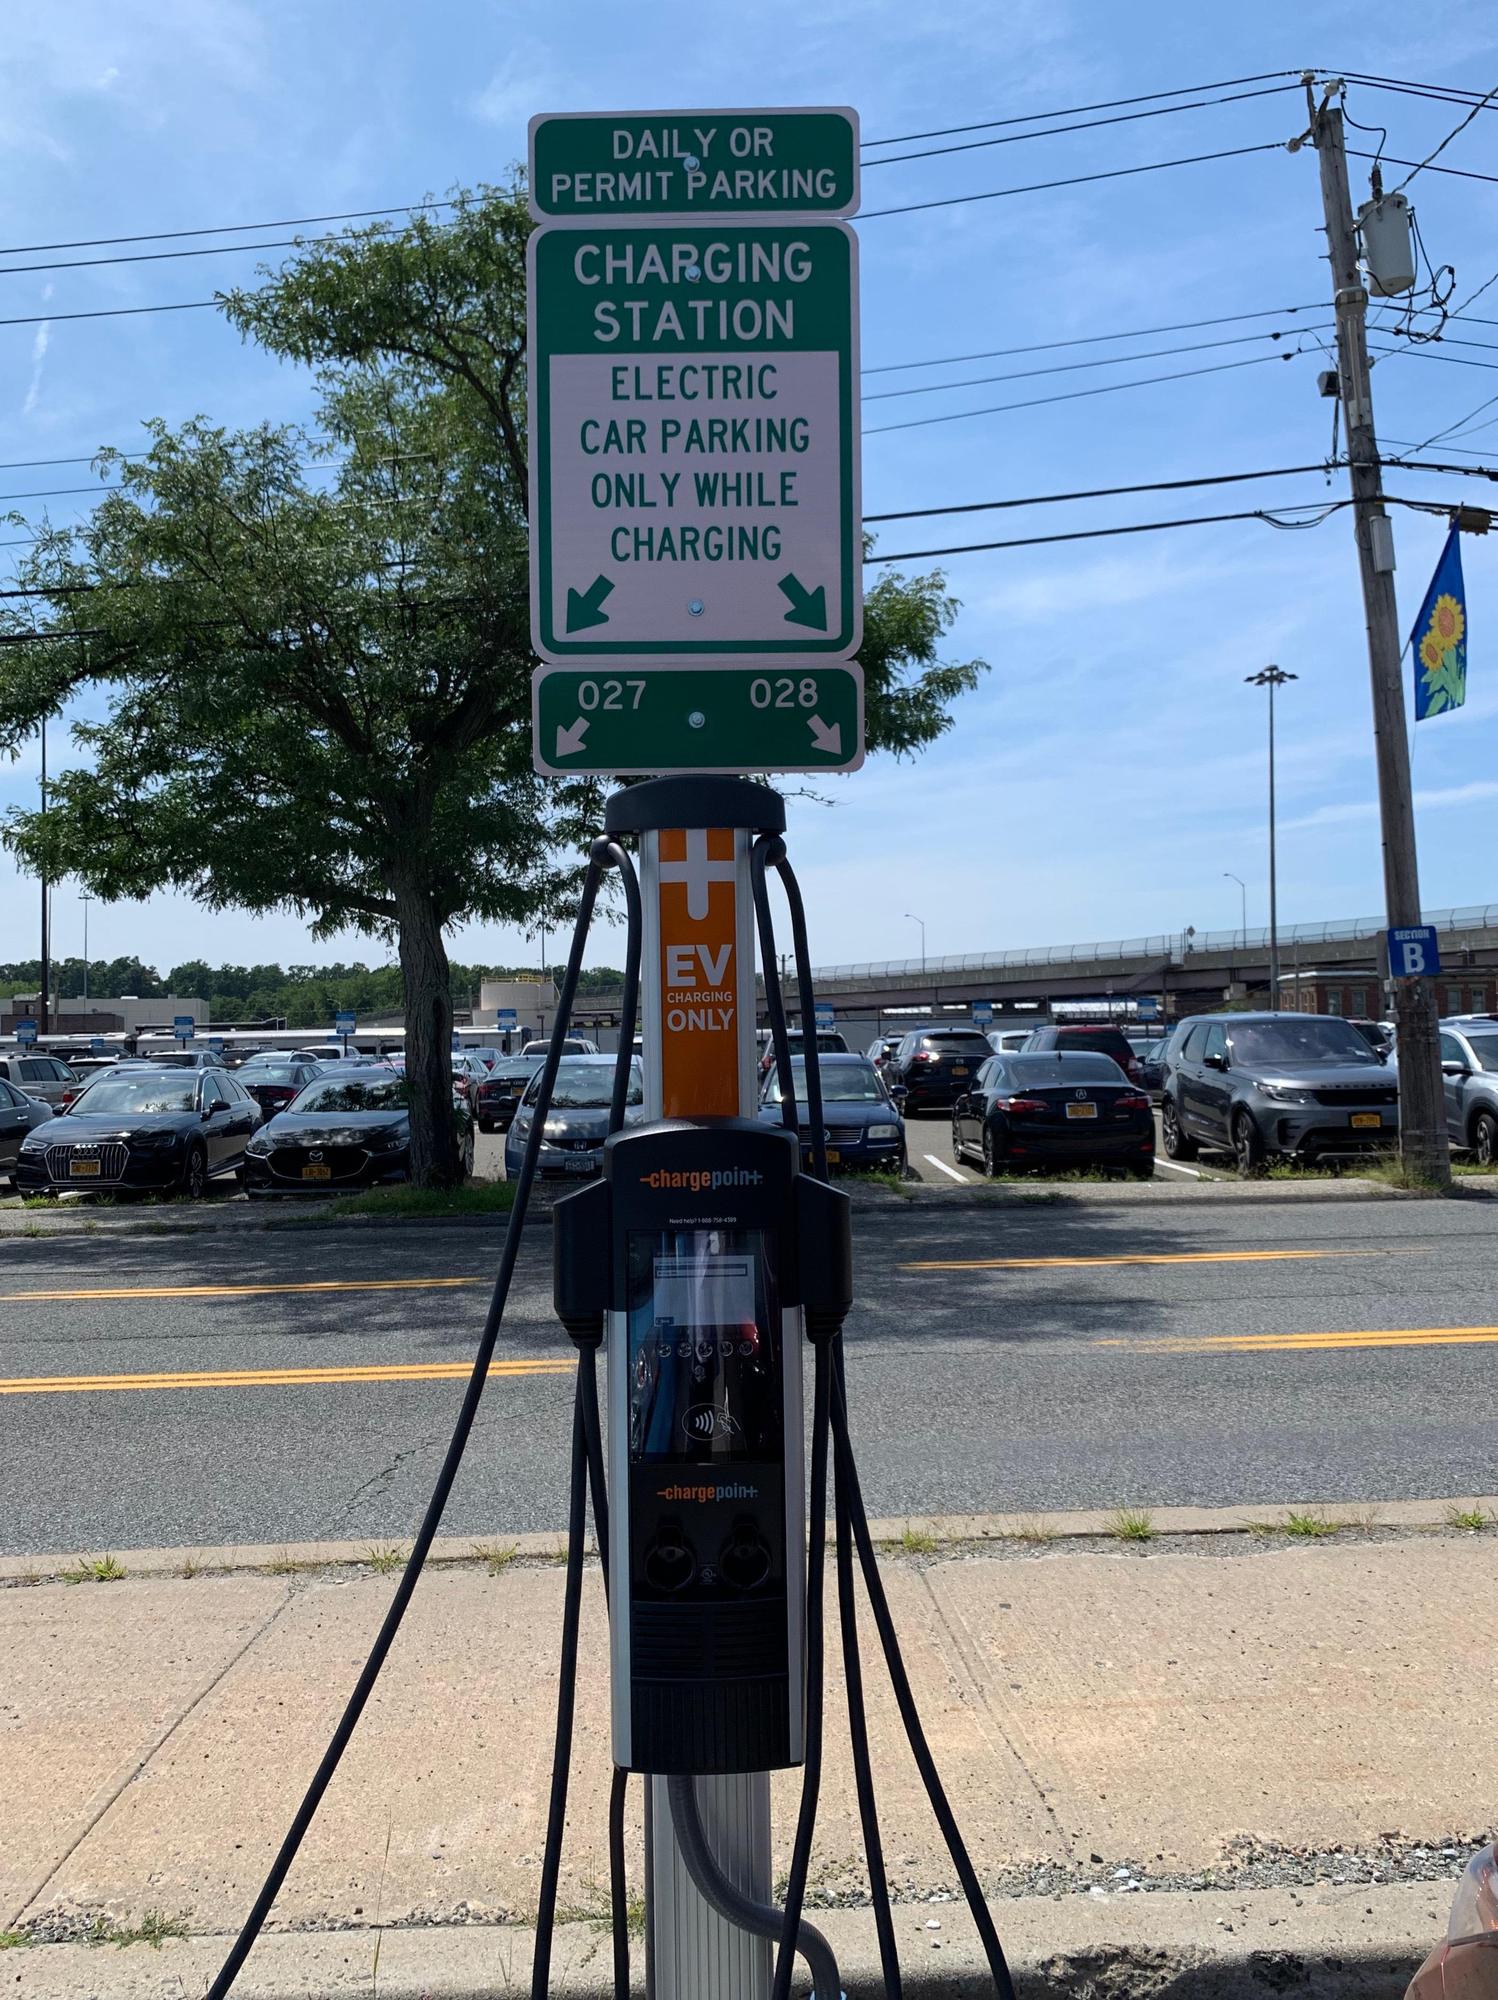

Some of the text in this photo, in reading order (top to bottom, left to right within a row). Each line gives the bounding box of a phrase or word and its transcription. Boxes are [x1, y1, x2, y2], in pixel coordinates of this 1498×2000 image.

[612, 127, 774, 159] DAILY OR
[551, 168, 837, 203] PERMIT PARKING
[574, 242, 813, 285] CHARGING
[593, 299, 795, 342] STATION
[611, 364, 778, 401] ELECTRIC
[580, 417, 810, 455] CAR PARKING
[591, 471, 799, 509] ONLY WHILE
[611, 525, 782, 562] CHARGING
[578, 680, 647, 710] 027
[750, 678, 819, 708] 028
[1394, 929, 1430, 941] SECTION
[666, 944, 733, 987] EV
[1402, 942, 1425, 974] B
[667, 991, 733, 1004] CHARGING
[667, 1008, 734, 1032] ONLY
